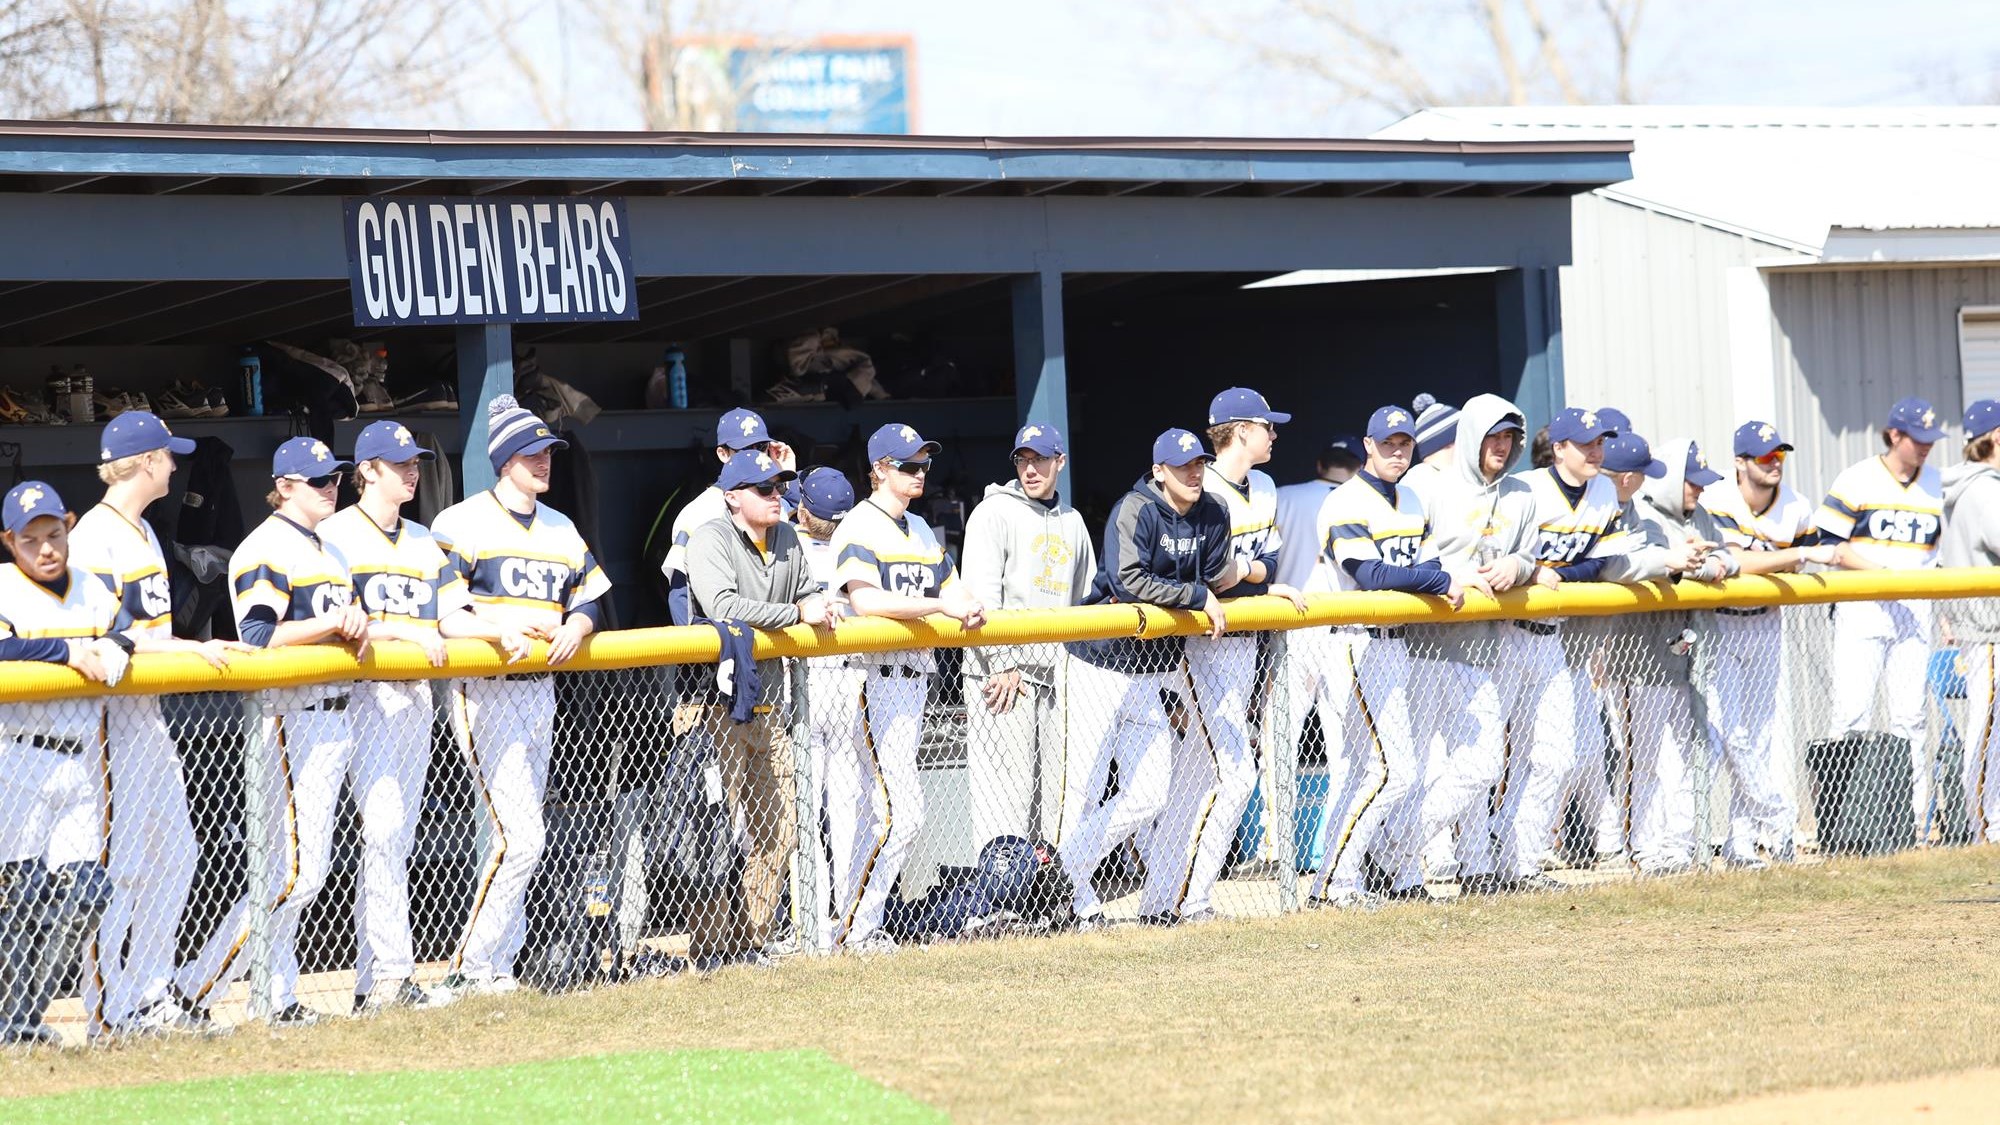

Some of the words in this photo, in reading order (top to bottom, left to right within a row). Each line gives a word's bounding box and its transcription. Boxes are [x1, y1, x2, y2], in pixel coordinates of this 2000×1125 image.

[358, 202, 507, 319] GOLDEN
[510, 201, 626, 315] BEARS
[1868, 509, 1938, 543] CSP
[1538, 532, 1592, 562] CSP
[363, 573, 433, 618] CSP
[500, 557, 570, 602] CSP
[889, 563, 935, 597] CSP
